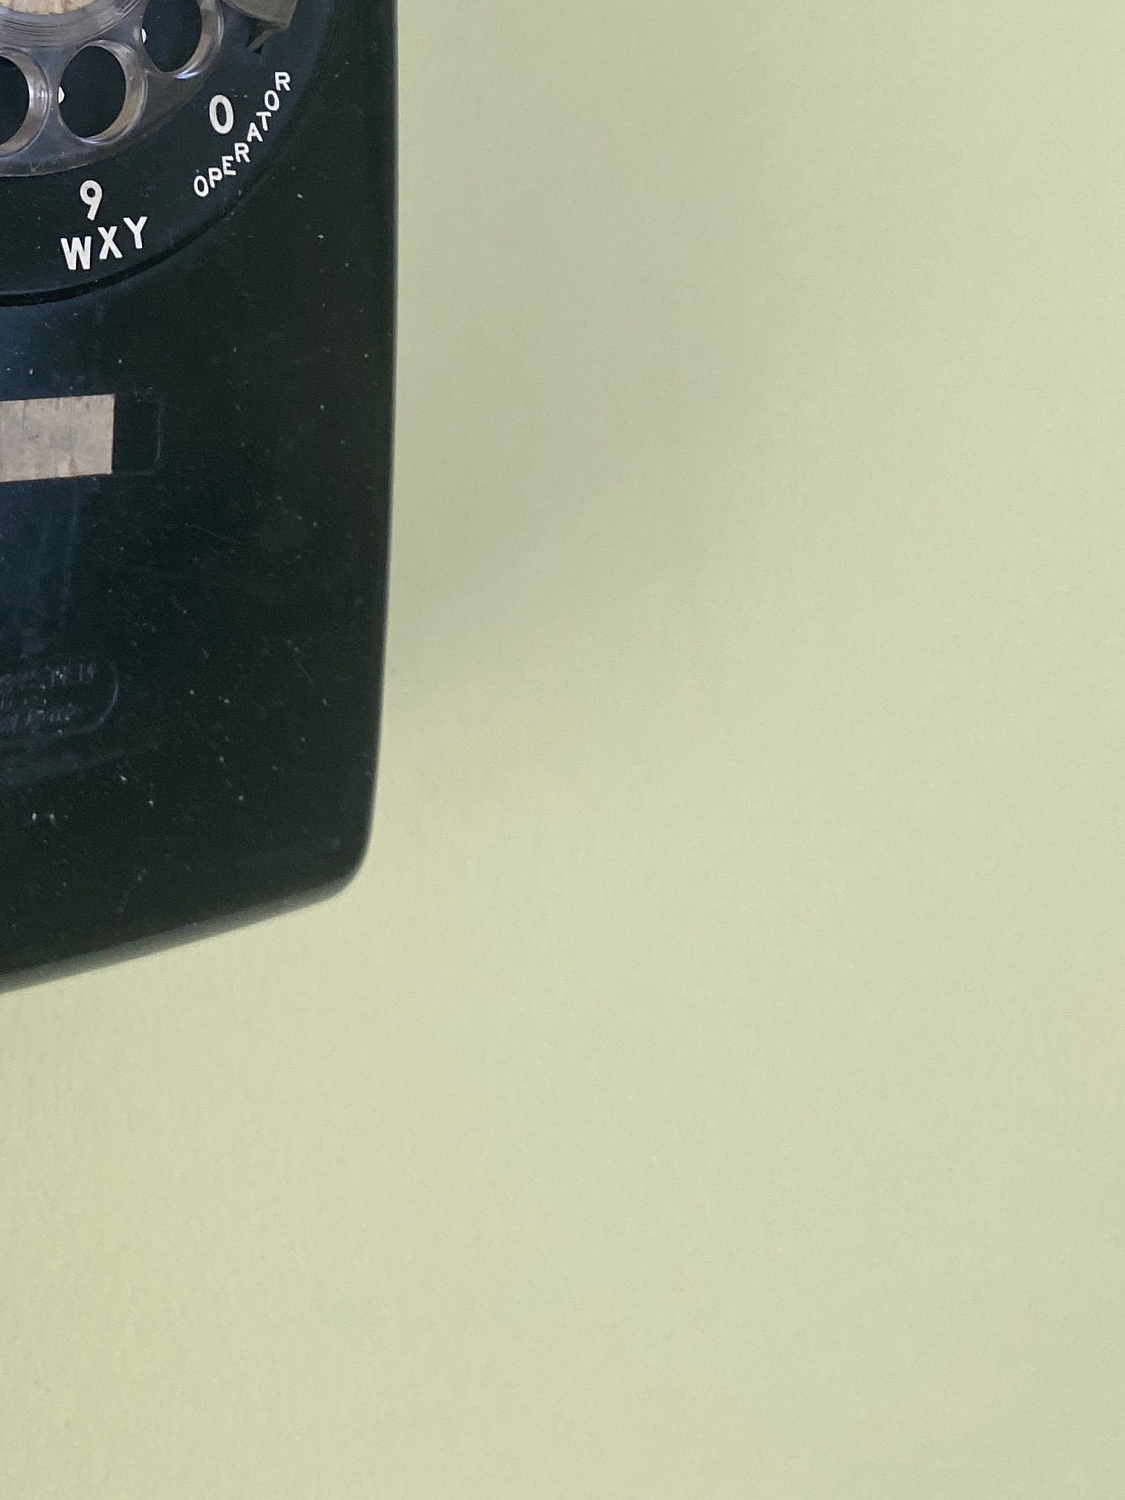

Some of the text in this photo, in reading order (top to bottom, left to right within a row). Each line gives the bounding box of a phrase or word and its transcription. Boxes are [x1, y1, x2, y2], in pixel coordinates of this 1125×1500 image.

[193, 71, 291, 198] OPERATOR
[79, 179, 103, 221] 9
[60, 216, 148, 271] WXY
